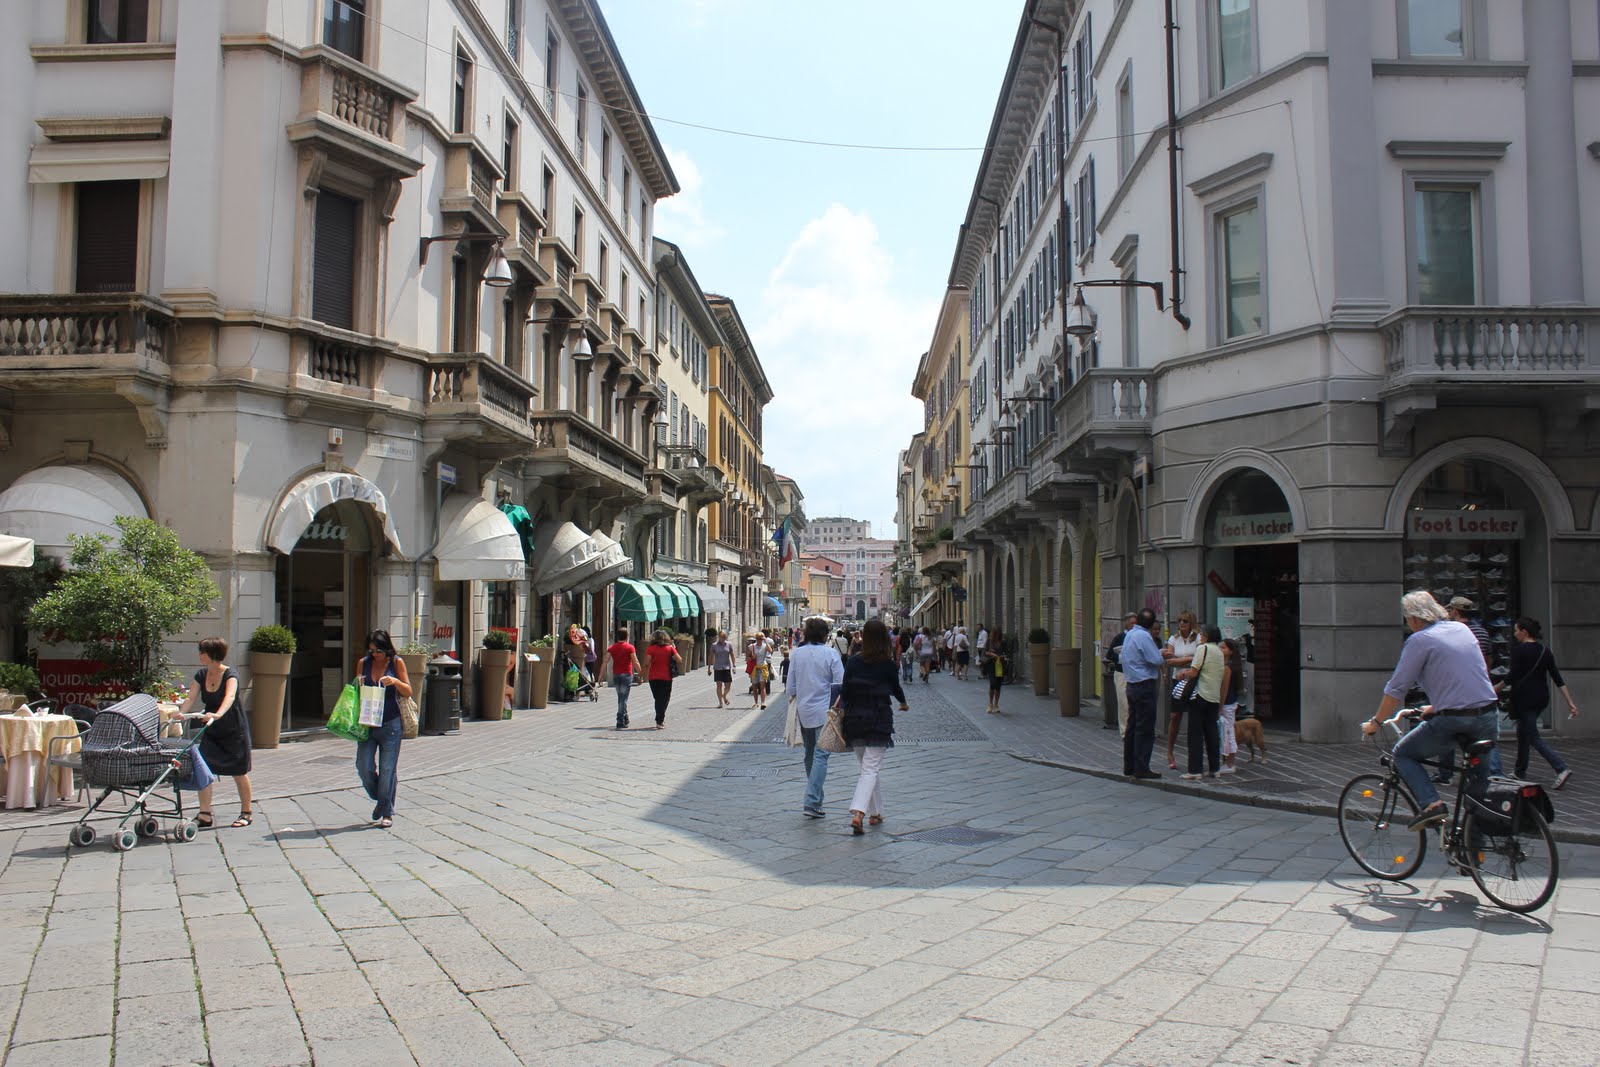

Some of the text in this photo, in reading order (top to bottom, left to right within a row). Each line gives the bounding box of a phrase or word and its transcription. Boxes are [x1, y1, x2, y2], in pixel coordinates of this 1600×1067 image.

[302, 520, 349, 540] ata
[1222, 520, 1293, 537] Foot Locker
[1415, 517, 1518, 532] Foot Locker
